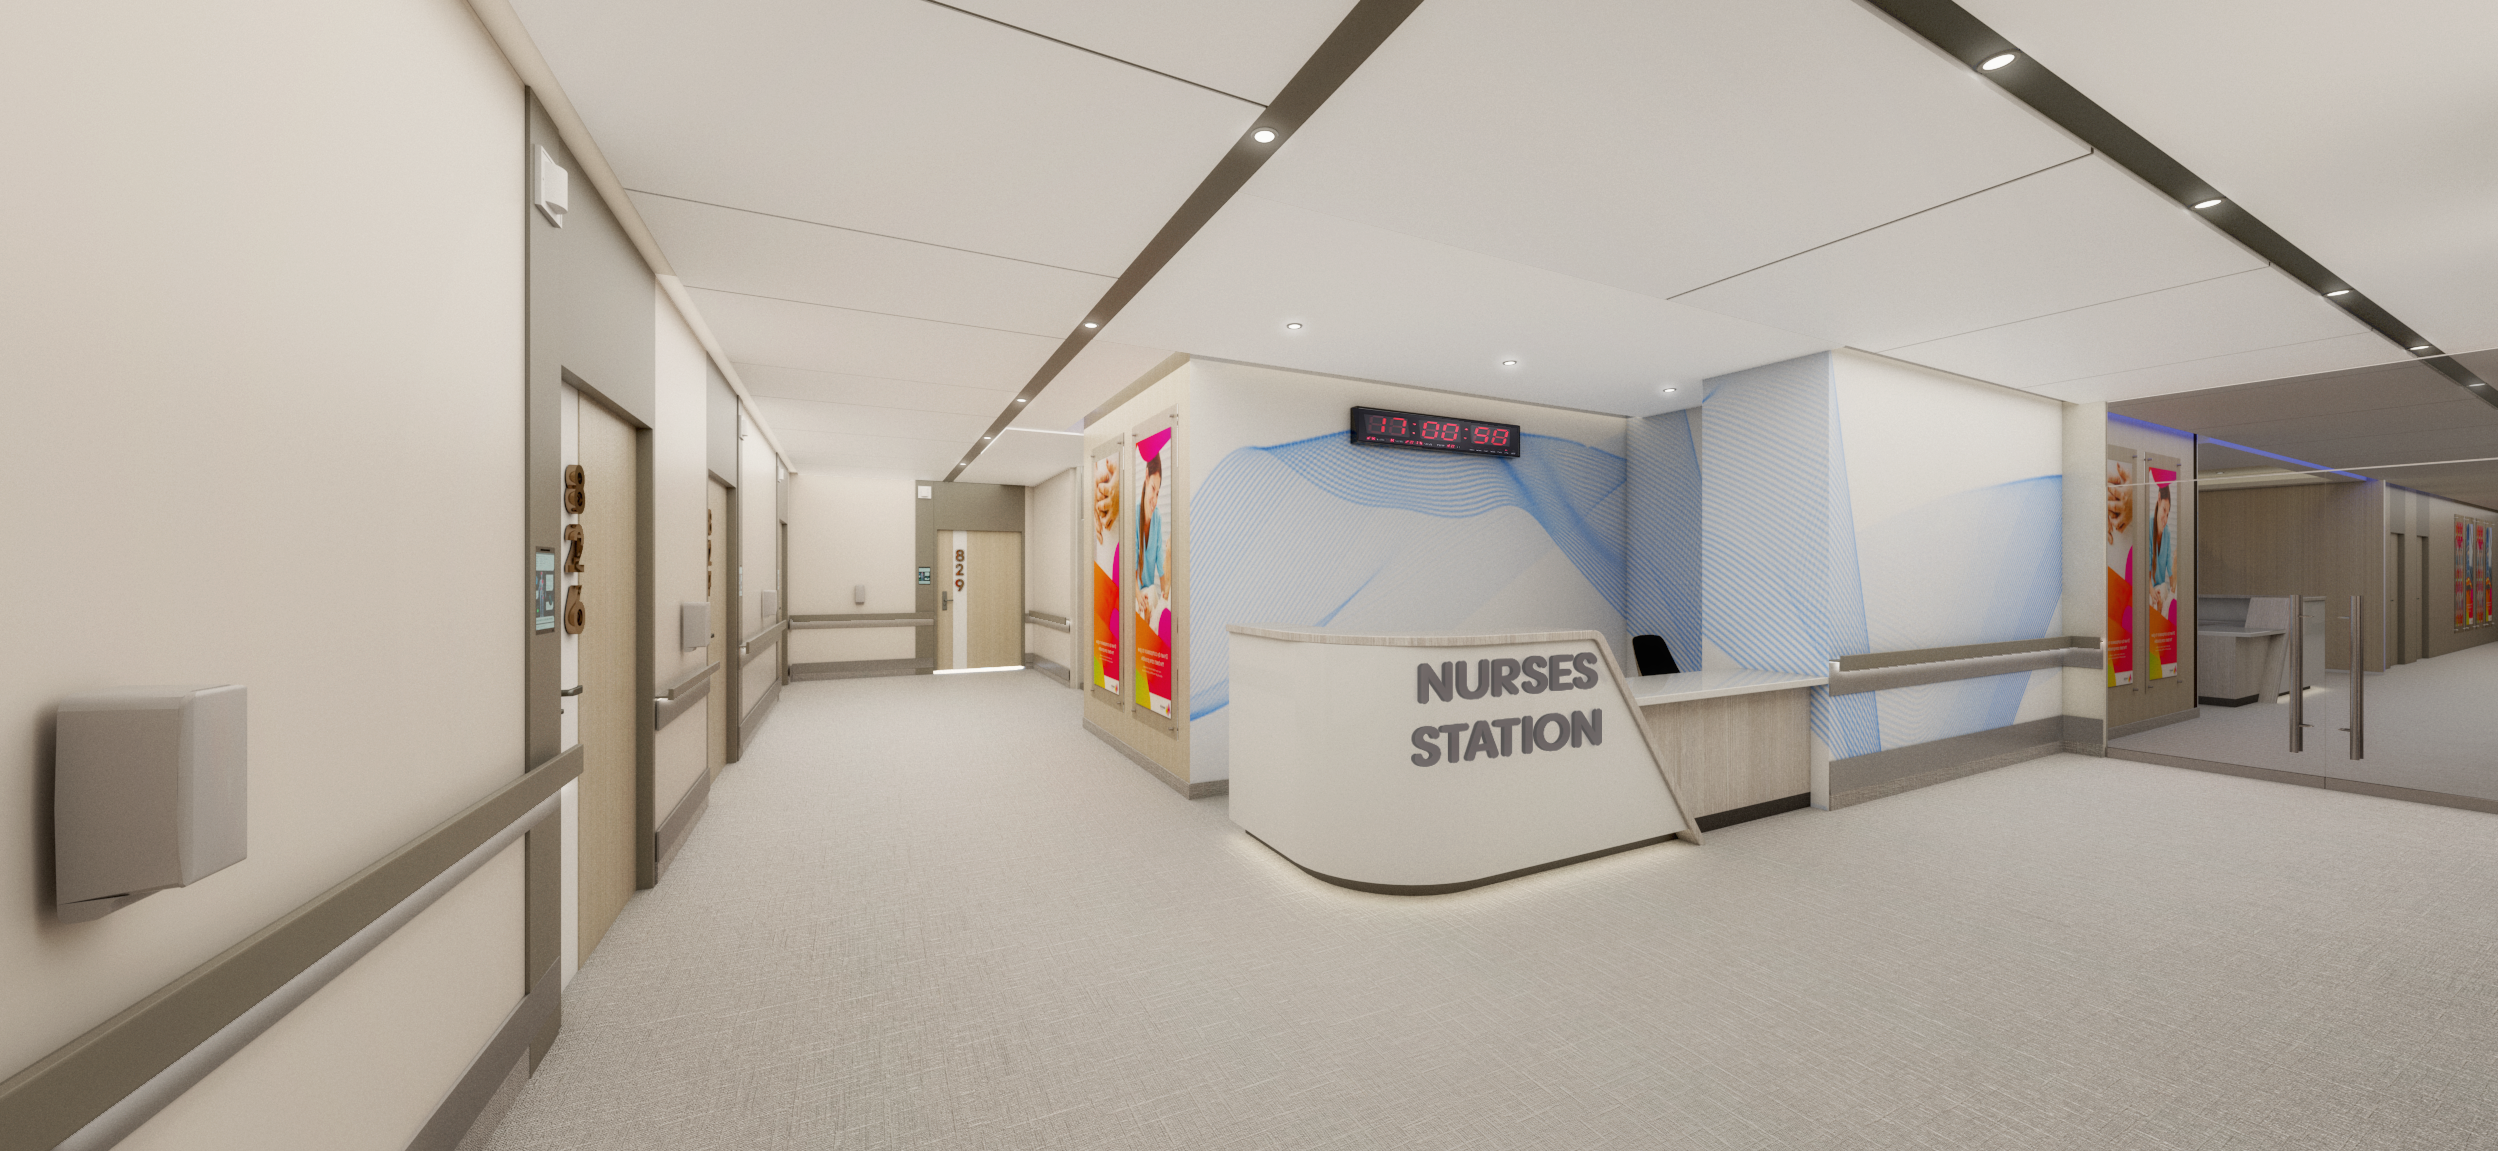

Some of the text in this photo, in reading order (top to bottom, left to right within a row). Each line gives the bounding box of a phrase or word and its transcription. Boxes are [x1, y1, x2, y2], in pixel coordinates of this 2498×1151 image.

[564, 464, 586, 635] 826
[954, 548, 966, 593] 829
[1417, 652, 1599, 705] NURSES
[1410, 708, 1603, 768] STATION
